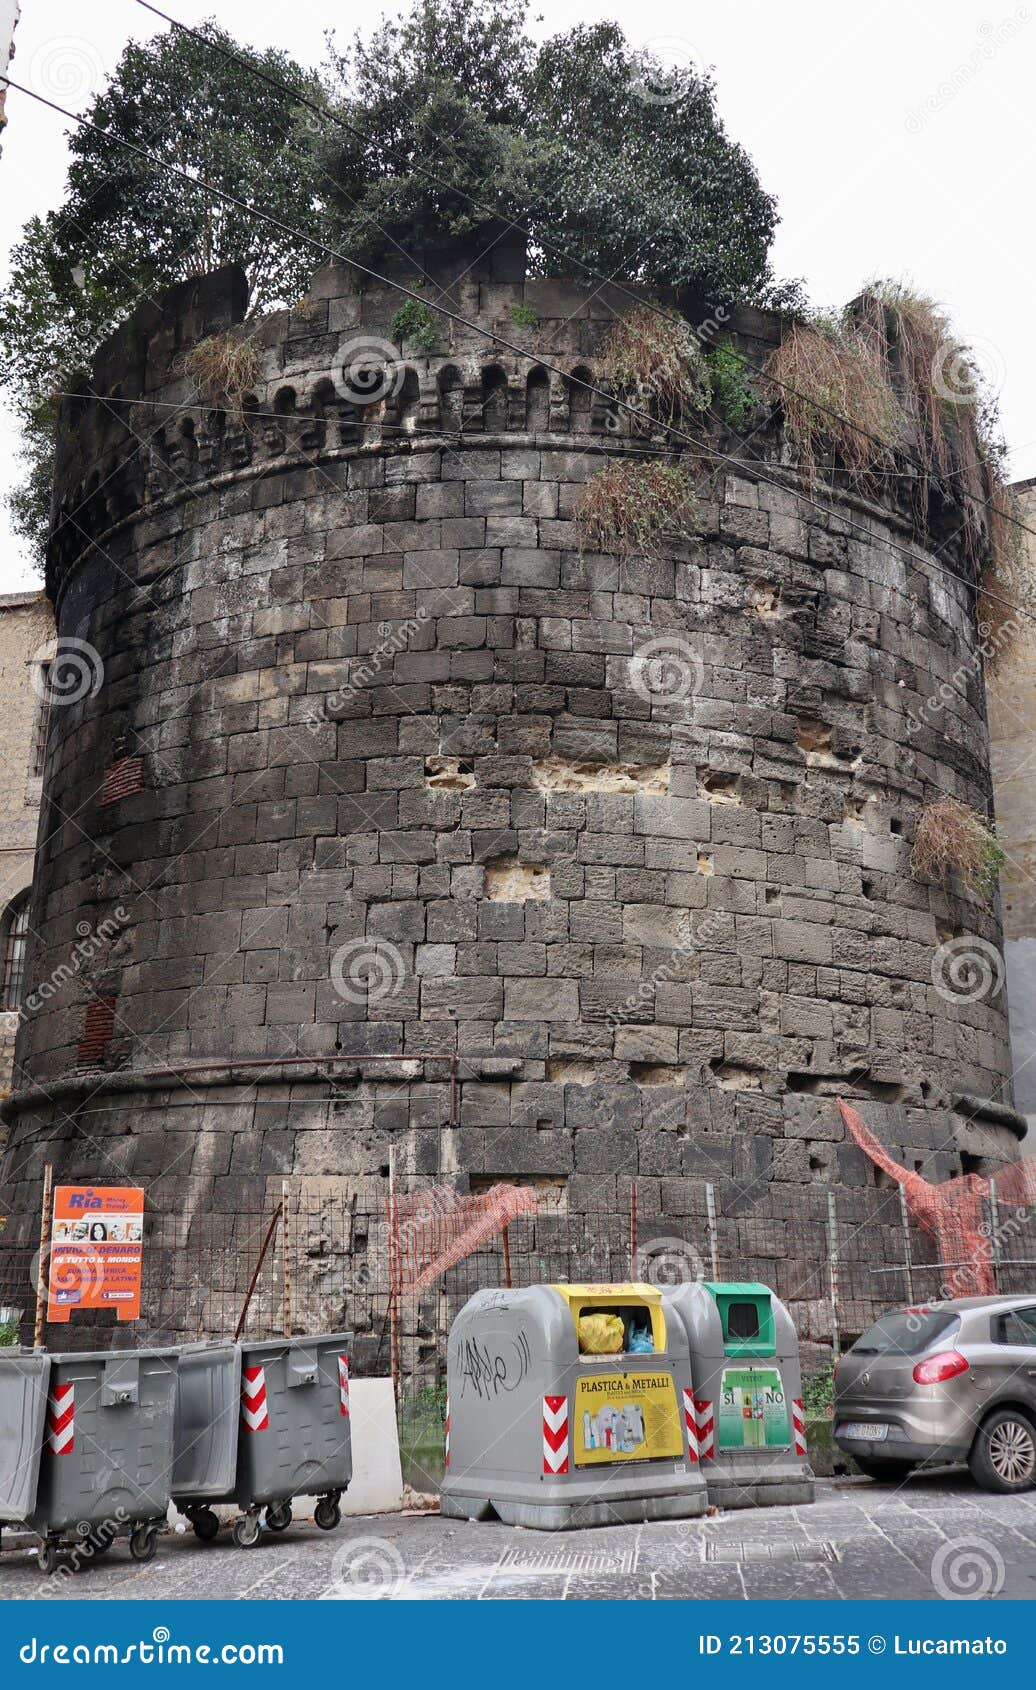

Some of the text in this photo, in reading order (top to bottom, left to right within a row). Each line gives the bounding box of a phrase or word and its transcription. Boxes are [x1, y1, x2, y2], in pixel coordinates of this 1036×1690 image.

[68, 1189, 102, 1209] Ria
[99, 1246, 140, 1254] DENARO
[54, 1256, 140, 1264] IN TUTTO IL MONDO
[581, 1380, 623, 1392] PLASTICA
[632, 1378, 669, 1390] METALLI
[765, 1392, 784, 1404] NO
